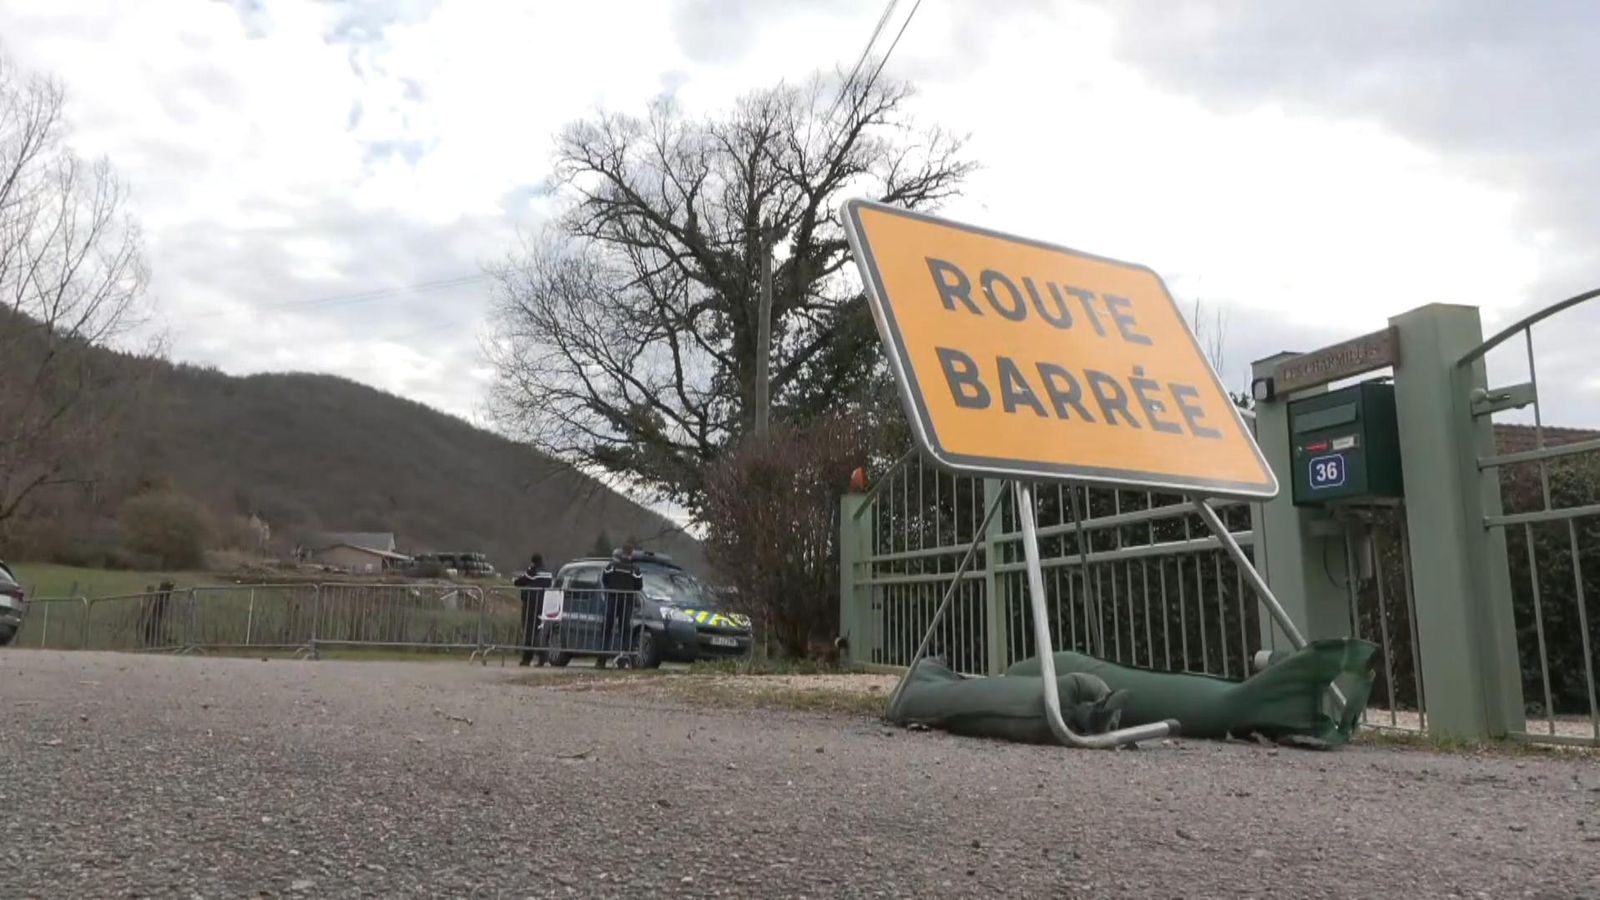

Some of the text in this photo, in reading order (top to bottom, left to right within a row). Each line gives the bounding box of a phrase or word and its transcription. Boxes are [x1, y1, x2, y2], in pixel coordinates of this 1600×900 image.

[924, 256, 1153, 346] ROUTE
[934, 346, 1223, 440] BARRÉE
[1316, 461, 1338, 481] 36
